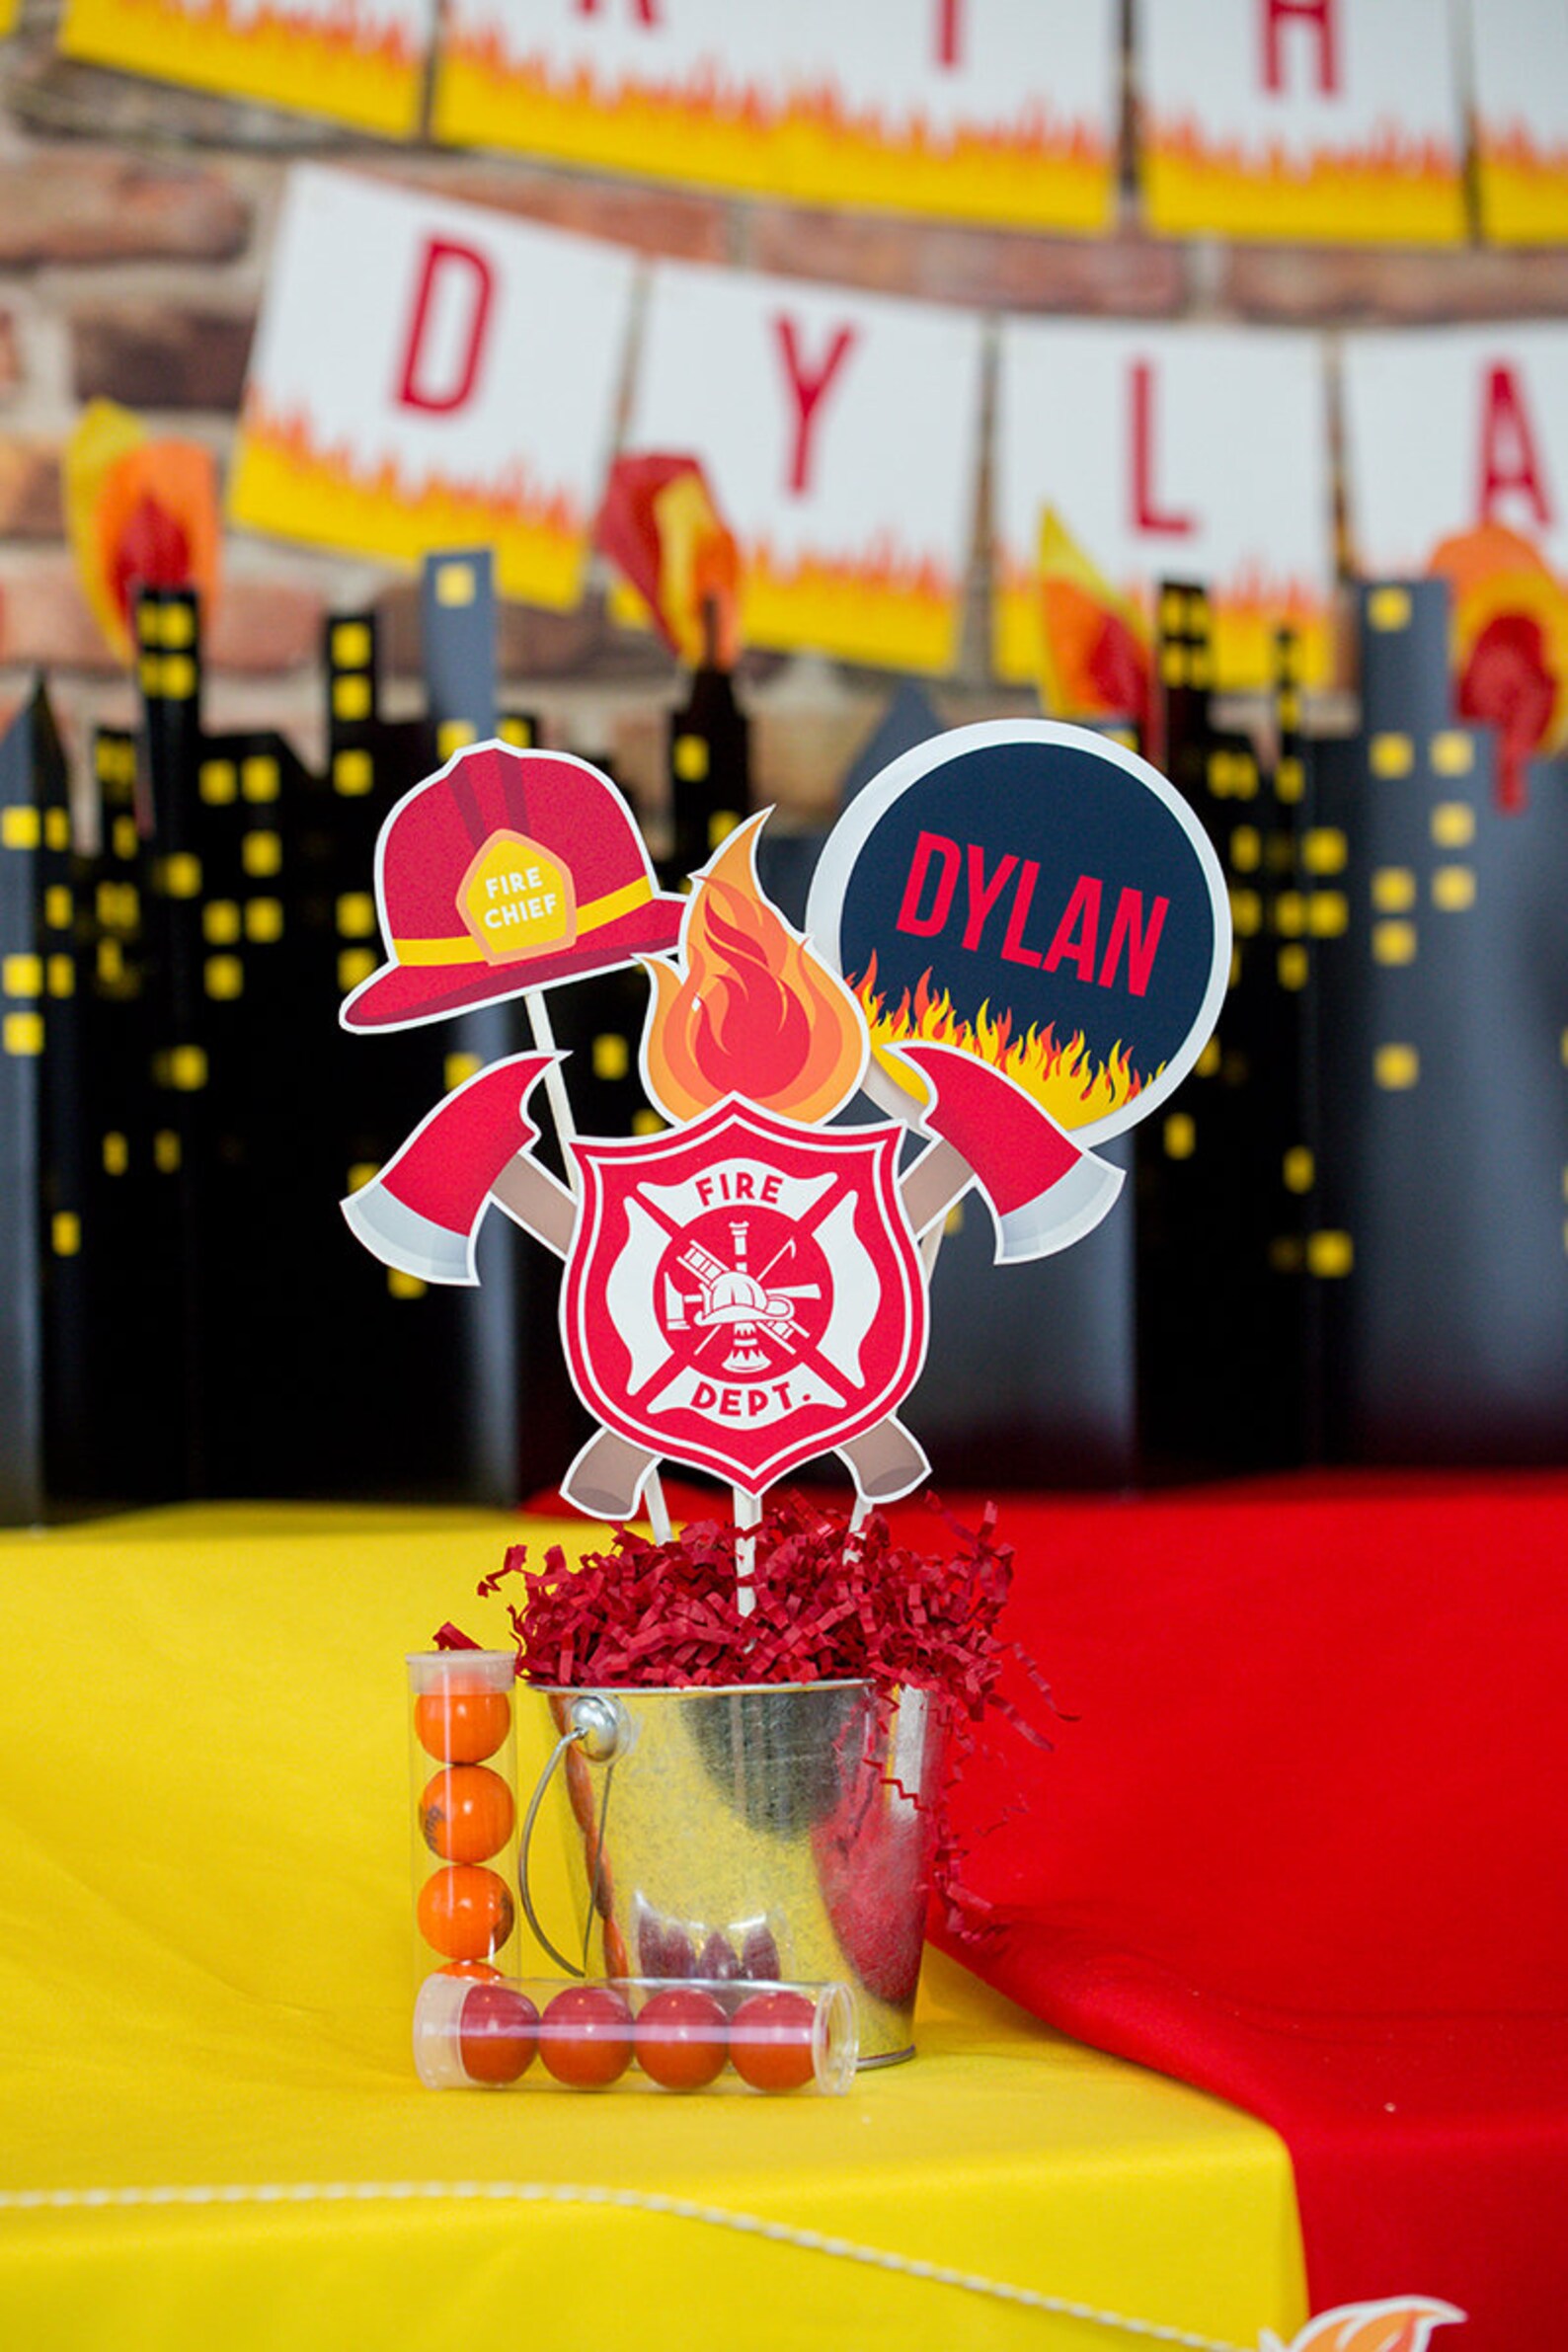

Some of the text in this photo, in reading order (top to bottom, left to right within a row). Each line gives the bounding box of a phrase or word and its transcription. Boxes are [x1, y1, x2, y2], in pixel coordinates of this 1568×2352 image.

[485, 866, 542, 899] FIRE
[484, 893, 556, 929] CHIEF
[896, 830, 1170, 997] DYLAN
[695, 1172, 783, 1207] FIRE
[690, 1381, 811, 1417] DEPT.
